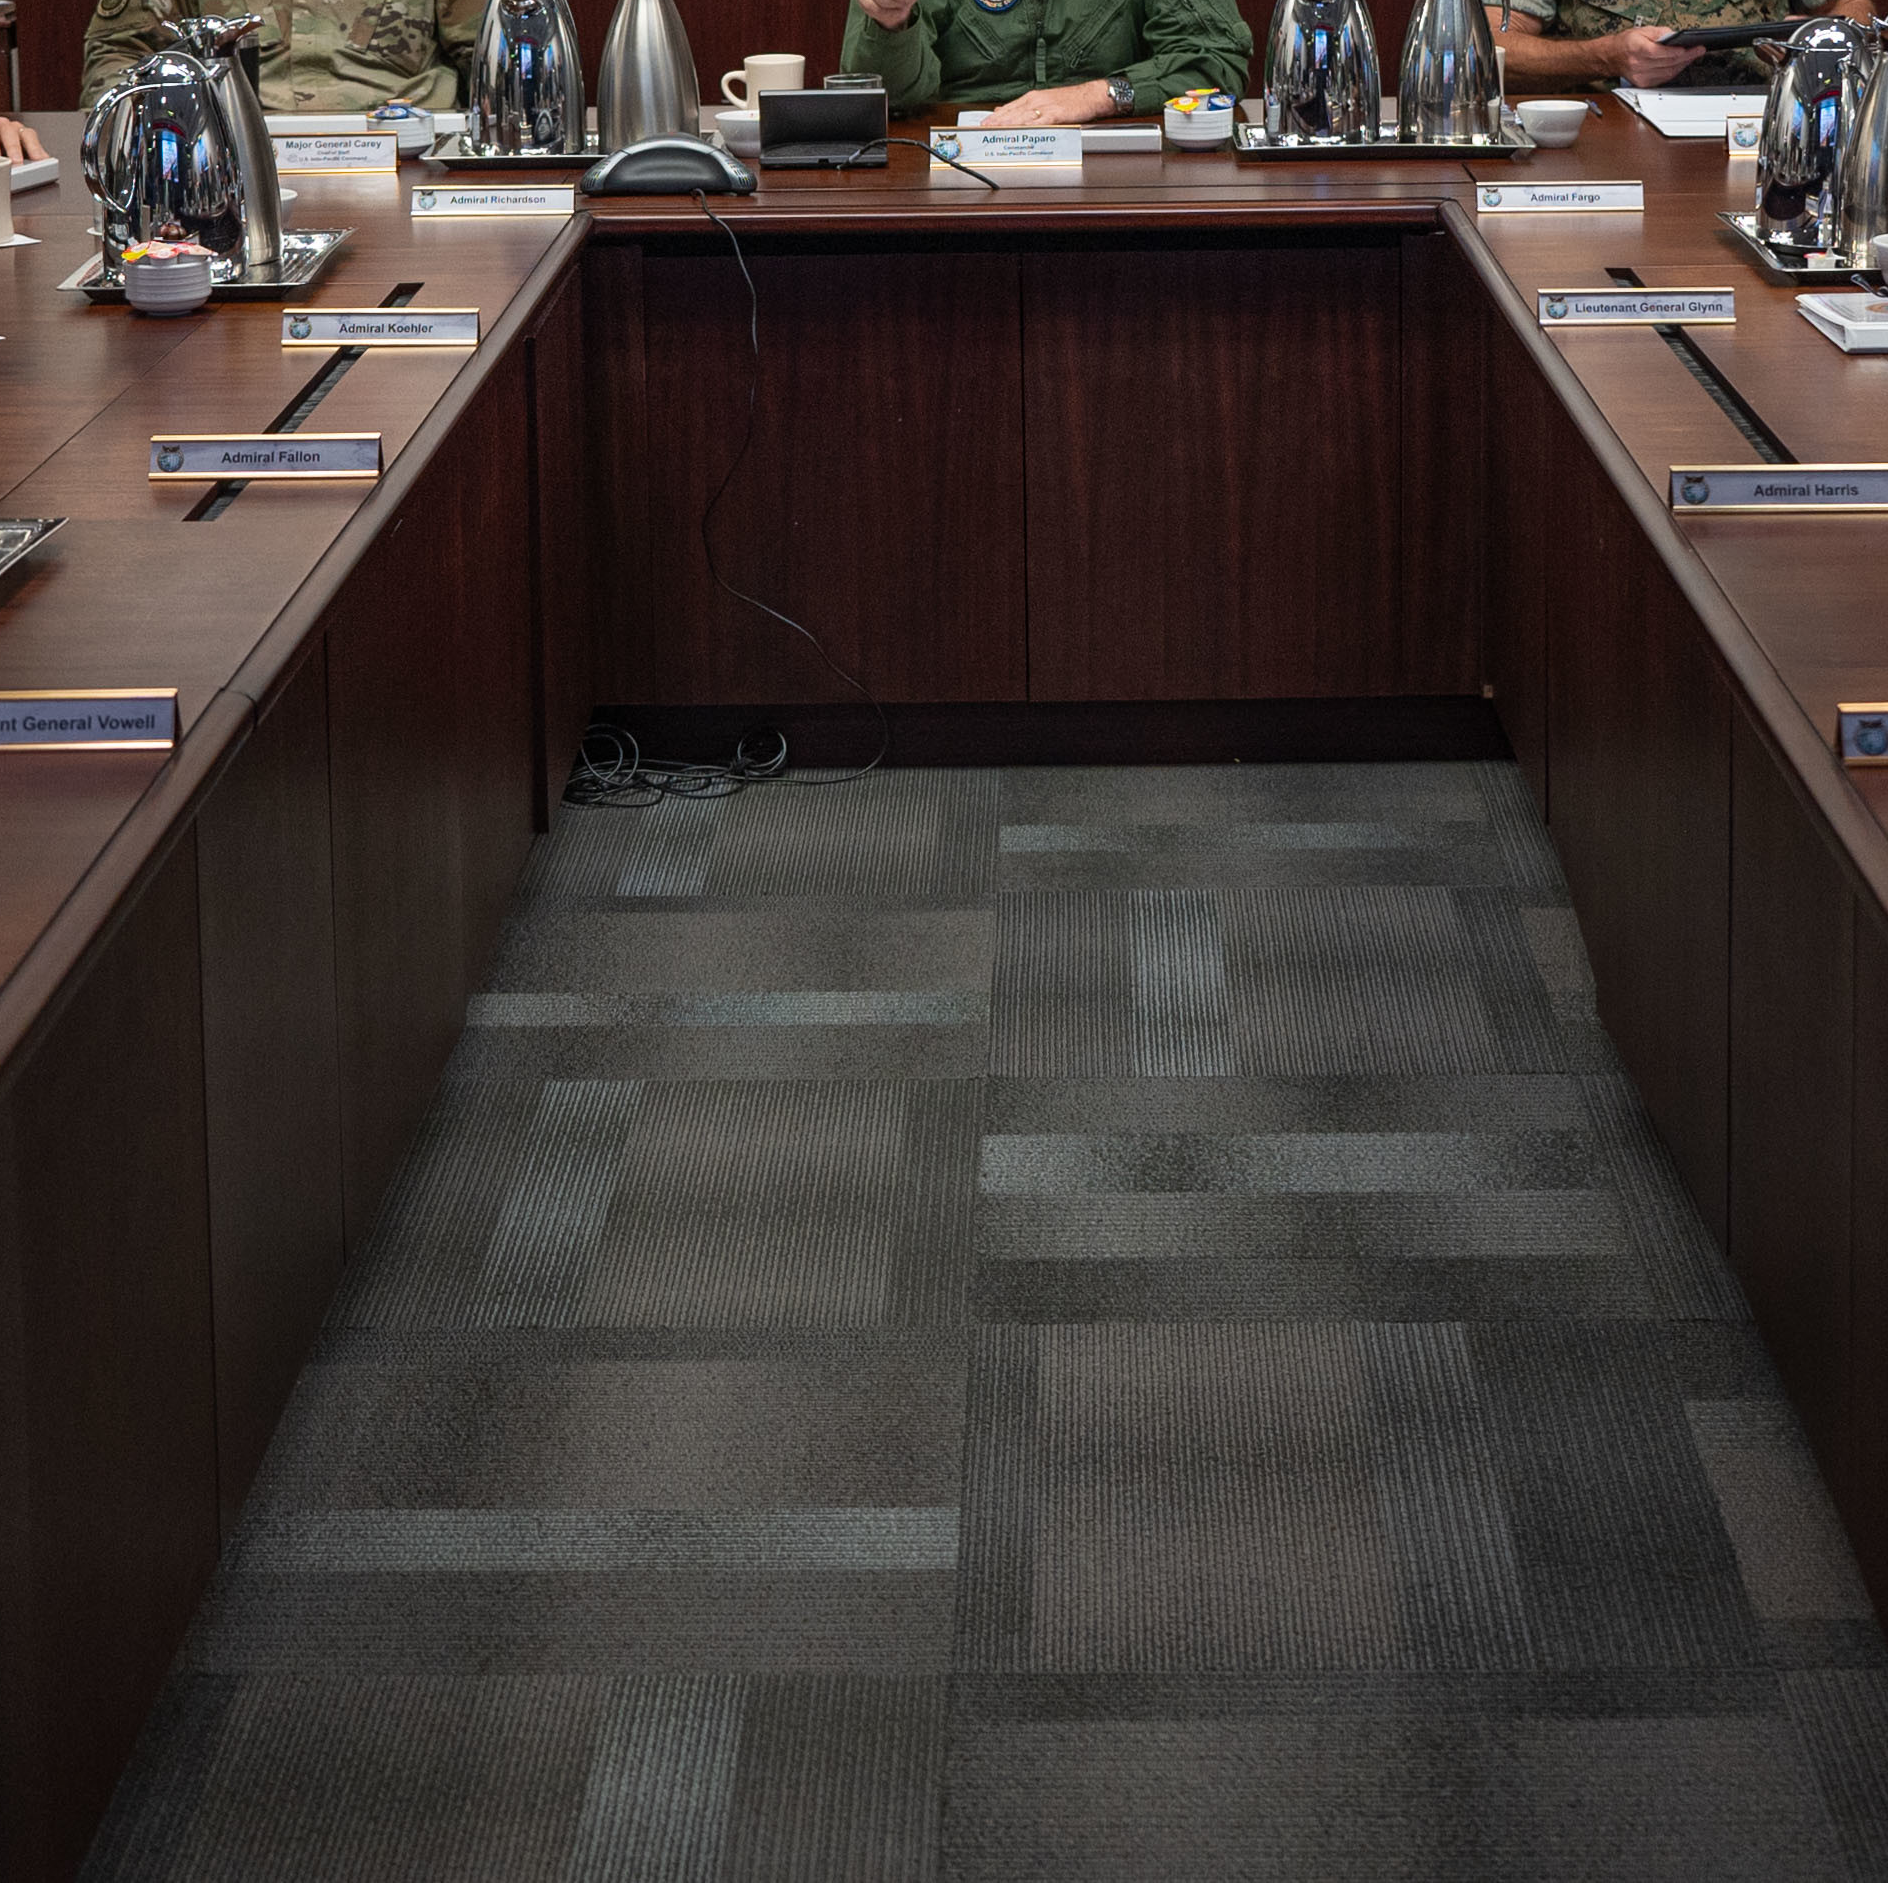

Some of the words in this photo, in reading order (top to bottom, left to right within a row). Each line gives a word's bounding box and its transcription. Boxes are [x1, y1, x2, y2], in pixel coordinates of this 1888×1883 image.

[285, 140, 312, 151] Major
[314, 140, 352, 149] General
[354, 139, 382, 150] Carey
[982, 135, 1019, 144] Admiral
[1022, 134, 1056, 145] Paparo
[450, 195, 488, 204] Admiral
[490, 195, 546, 204] Richardson
[1530, 193, 1569, 202] Admiral
[1571, 192, 1601, 204] Fargo
[1575, 302, 1637, 313] Lieutenant
[1639, 302, 1685, 313] General
[1688, 301, 1723, 315] Glynn
[339, 323, 385, 334] Admiral
[388, 323, 434, 334] Koehler
[221, 451, 275, 464] Admiral
[278, 450, 321, 463] Fallon
[1754, 483, 1810, 497] Admiral
[1814, 483, 1860, 496] Harris
[22, 716, 92, 732] General
[96, 714, 156, 731] Vowell
